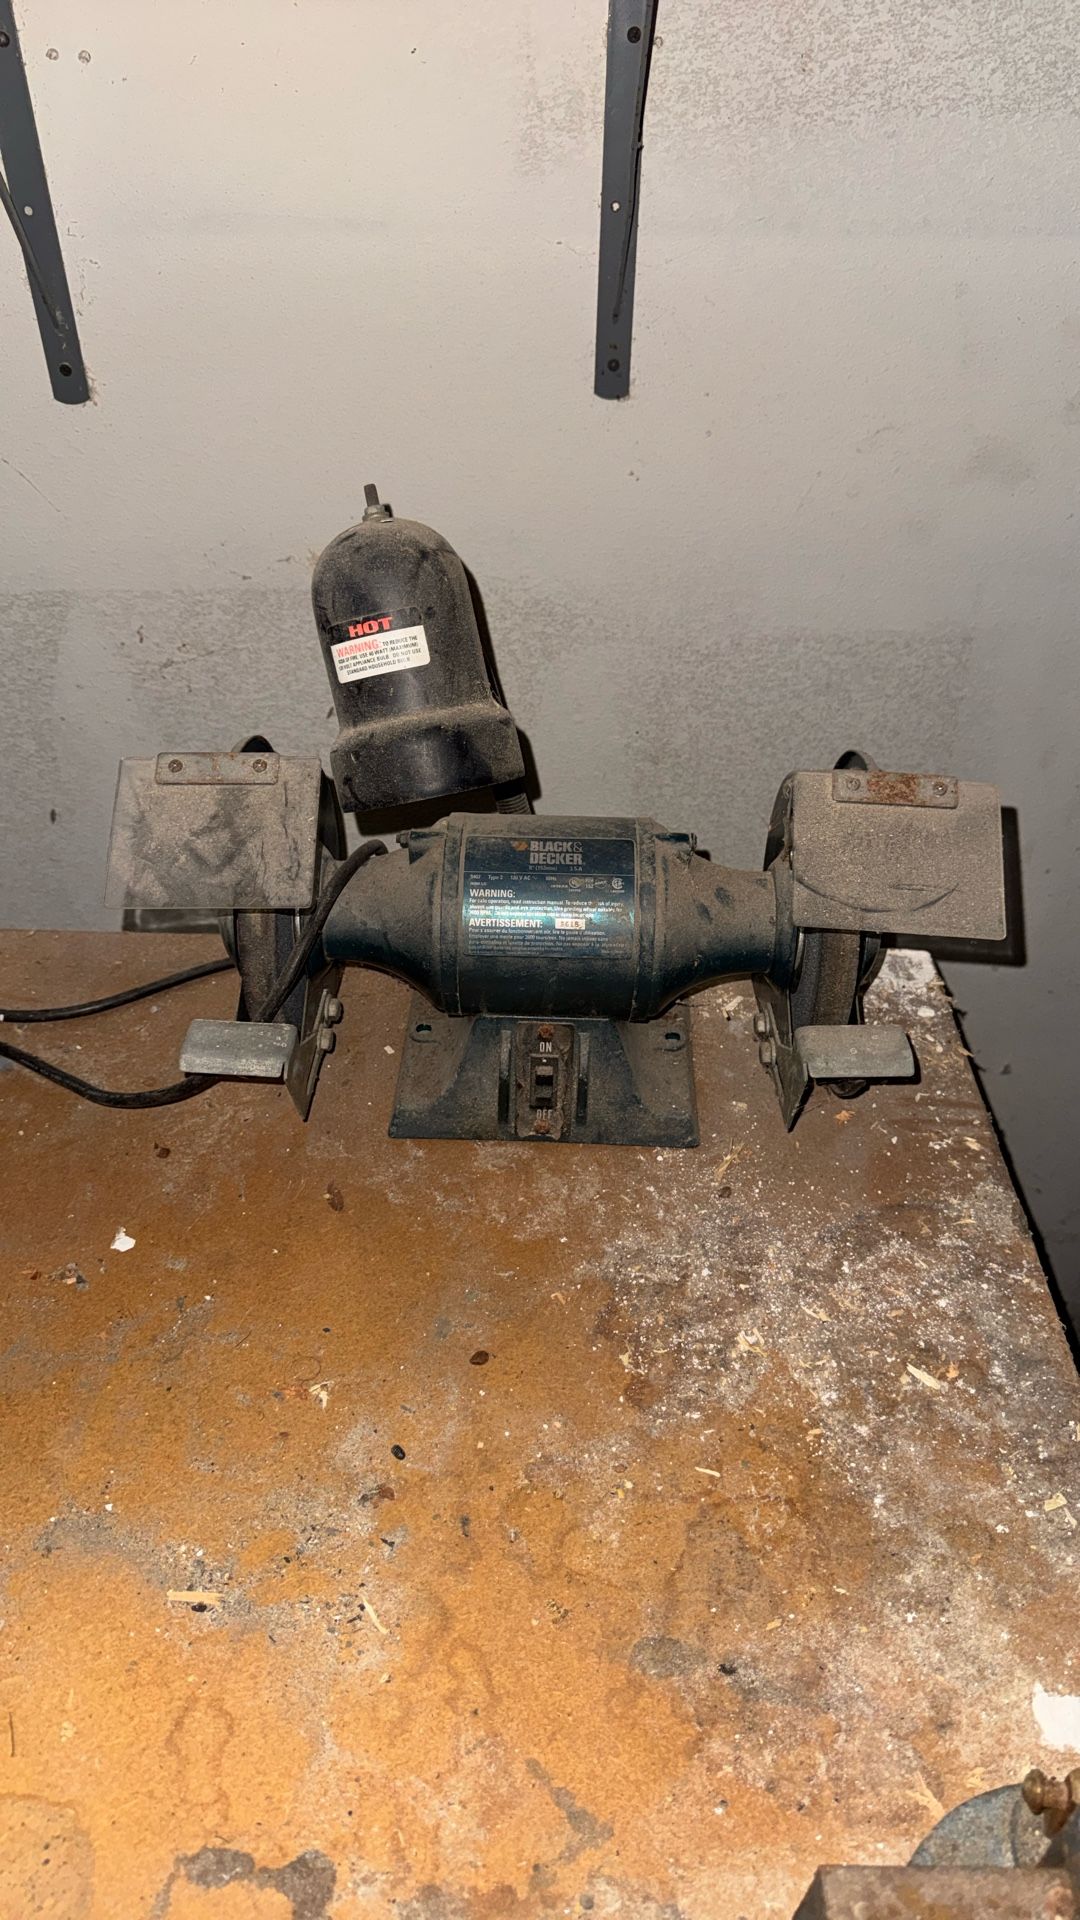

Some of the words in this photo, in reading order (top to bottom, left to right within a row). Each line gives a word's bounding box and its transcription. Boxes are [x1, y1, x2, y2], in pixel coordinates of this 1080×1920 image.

[348, 616, 393, 638] HOT
[336, 639, 382, 658] WARNING:
[374, 647, 389, 656] WATT
[346, 664, 368, 675] STANDARD
[368, 659, 397, 670] HOUSEHOLD
[352, 657, 376, 667] APPLIANCE
[529, 853, 583, 865] DECKER
[469, 889, 516, 898] WARNING:
[468, 918, 544, 929] AVERTISSEMENT:
[540, 1041, 552, 1053] ON
[537, 1109, 553, 1120] OFF
